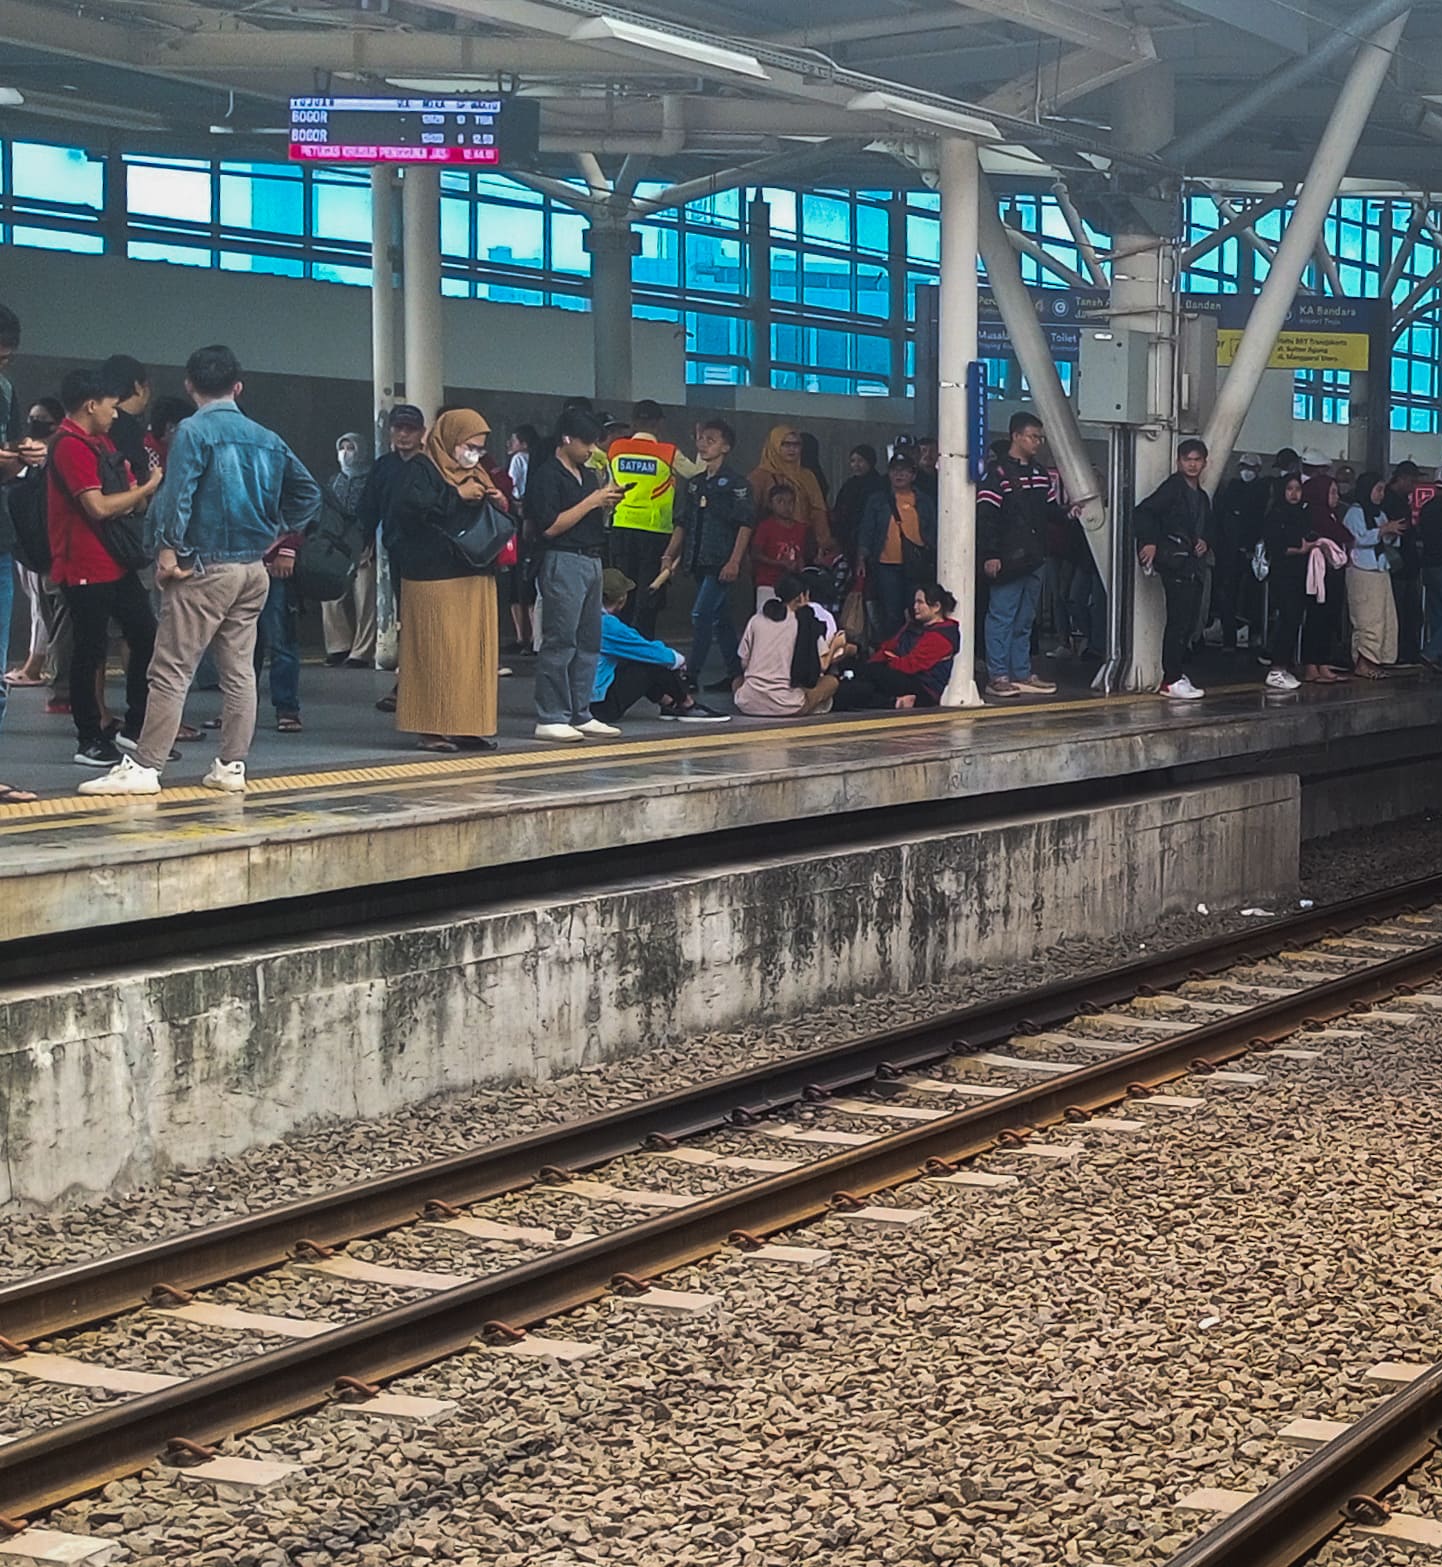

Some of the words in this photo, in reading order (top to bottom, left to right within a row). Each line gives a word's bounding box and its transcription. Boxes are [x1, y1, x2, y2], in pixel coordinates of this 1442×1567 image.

[292, 111, 328, 123] BOGOR
[291, 129, 328, 142] BOGOR
[1299, 305, 1314, 315] KA
[1316, 306, 1356, 317] Bandara
[1050, 333, 1077, 342] Toilet
[619, 459, 656, 474] SATPAM
